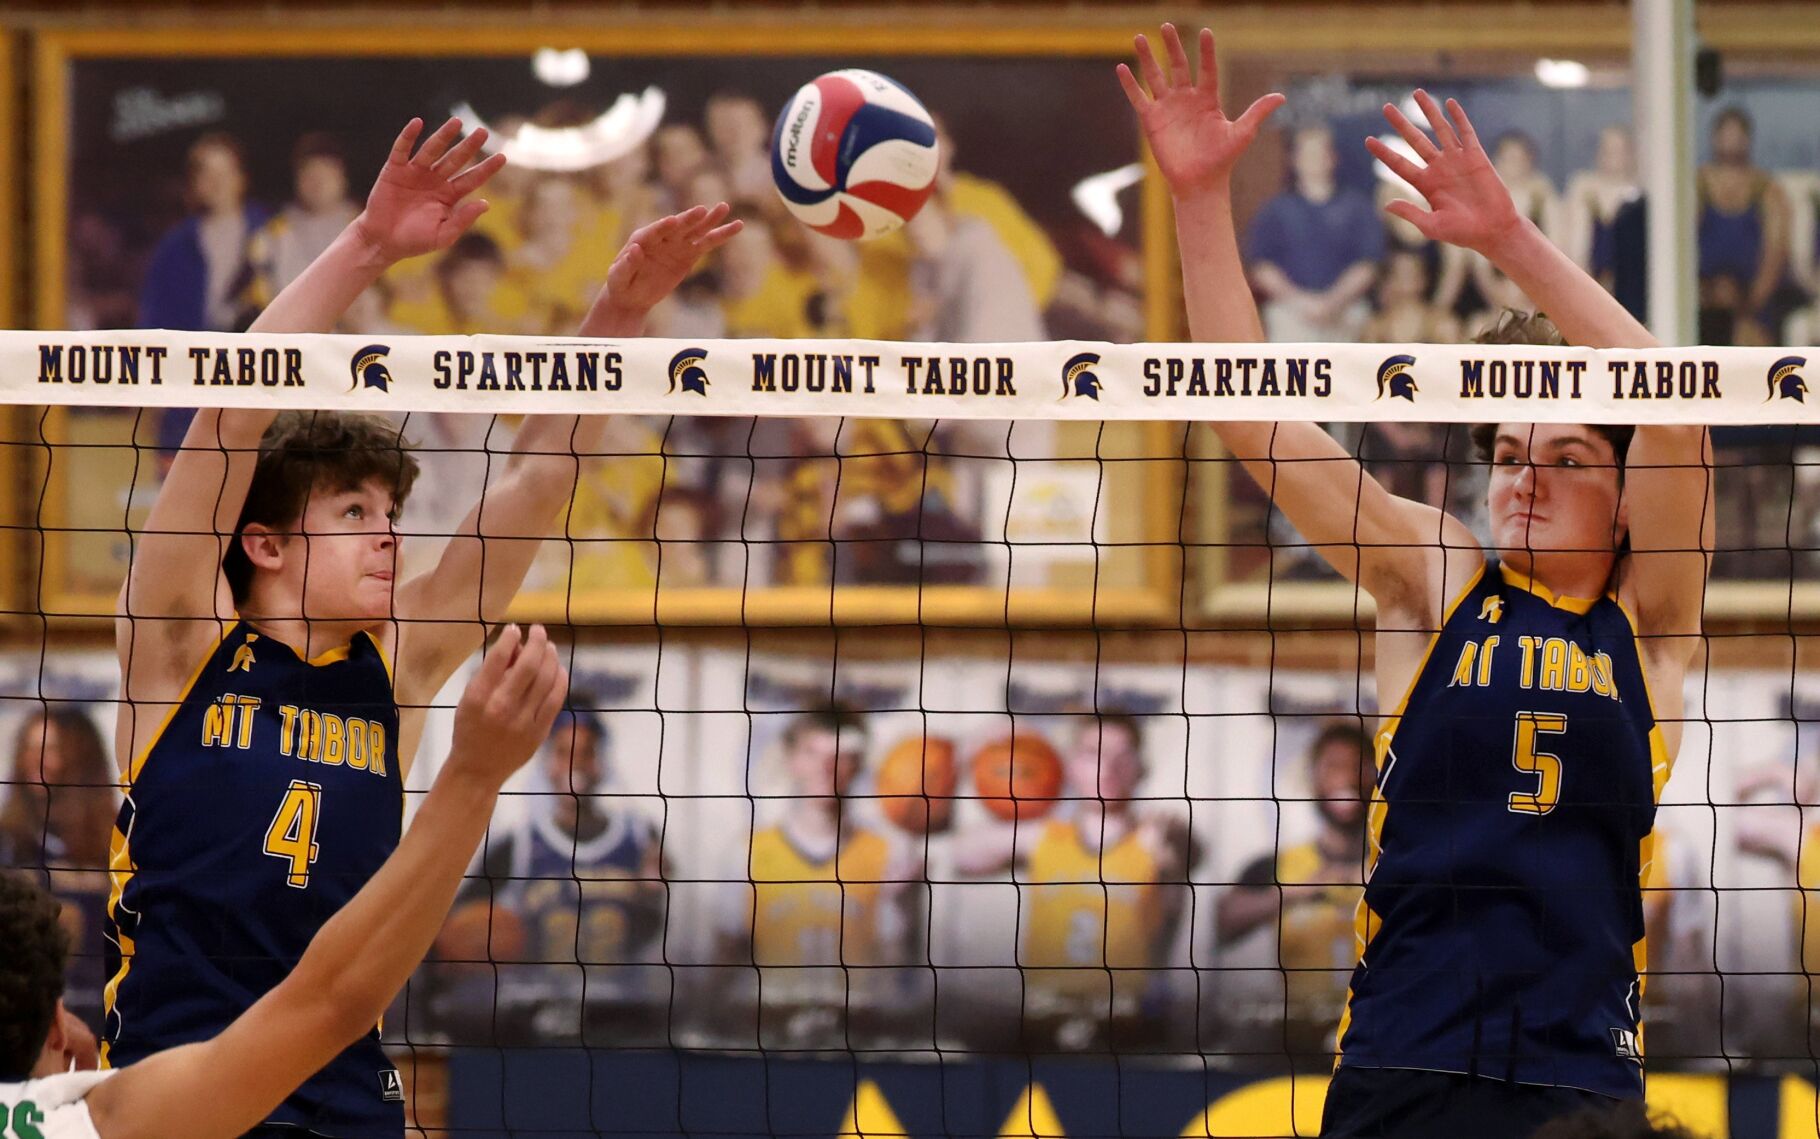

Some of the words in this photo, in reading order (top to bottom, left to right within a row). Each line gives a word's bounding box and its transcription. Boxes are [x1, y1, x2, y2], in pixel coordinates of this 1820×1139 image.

[786, 99, 815, 169] molten
[38, 345, 168, 385] MOUNT
[188, 347, 305, 387] TABOR
[433, 350, 623, 392] SPARTANS
[751, 353, 880, 394] MOUNT
[901, 356, 1017, 396] TABOR
[1143, 358, 1332, 398] SPARTANS
[1459, 360, 1587, 399] MOUNT
[1608, 361, 1722, 399] TABOR
[202, 692, 262, 750] MT
[279, 704, 387, 777] TABOR
[1507, 710, 1567, 816] 5
[263, 779, 322, 890] 4
